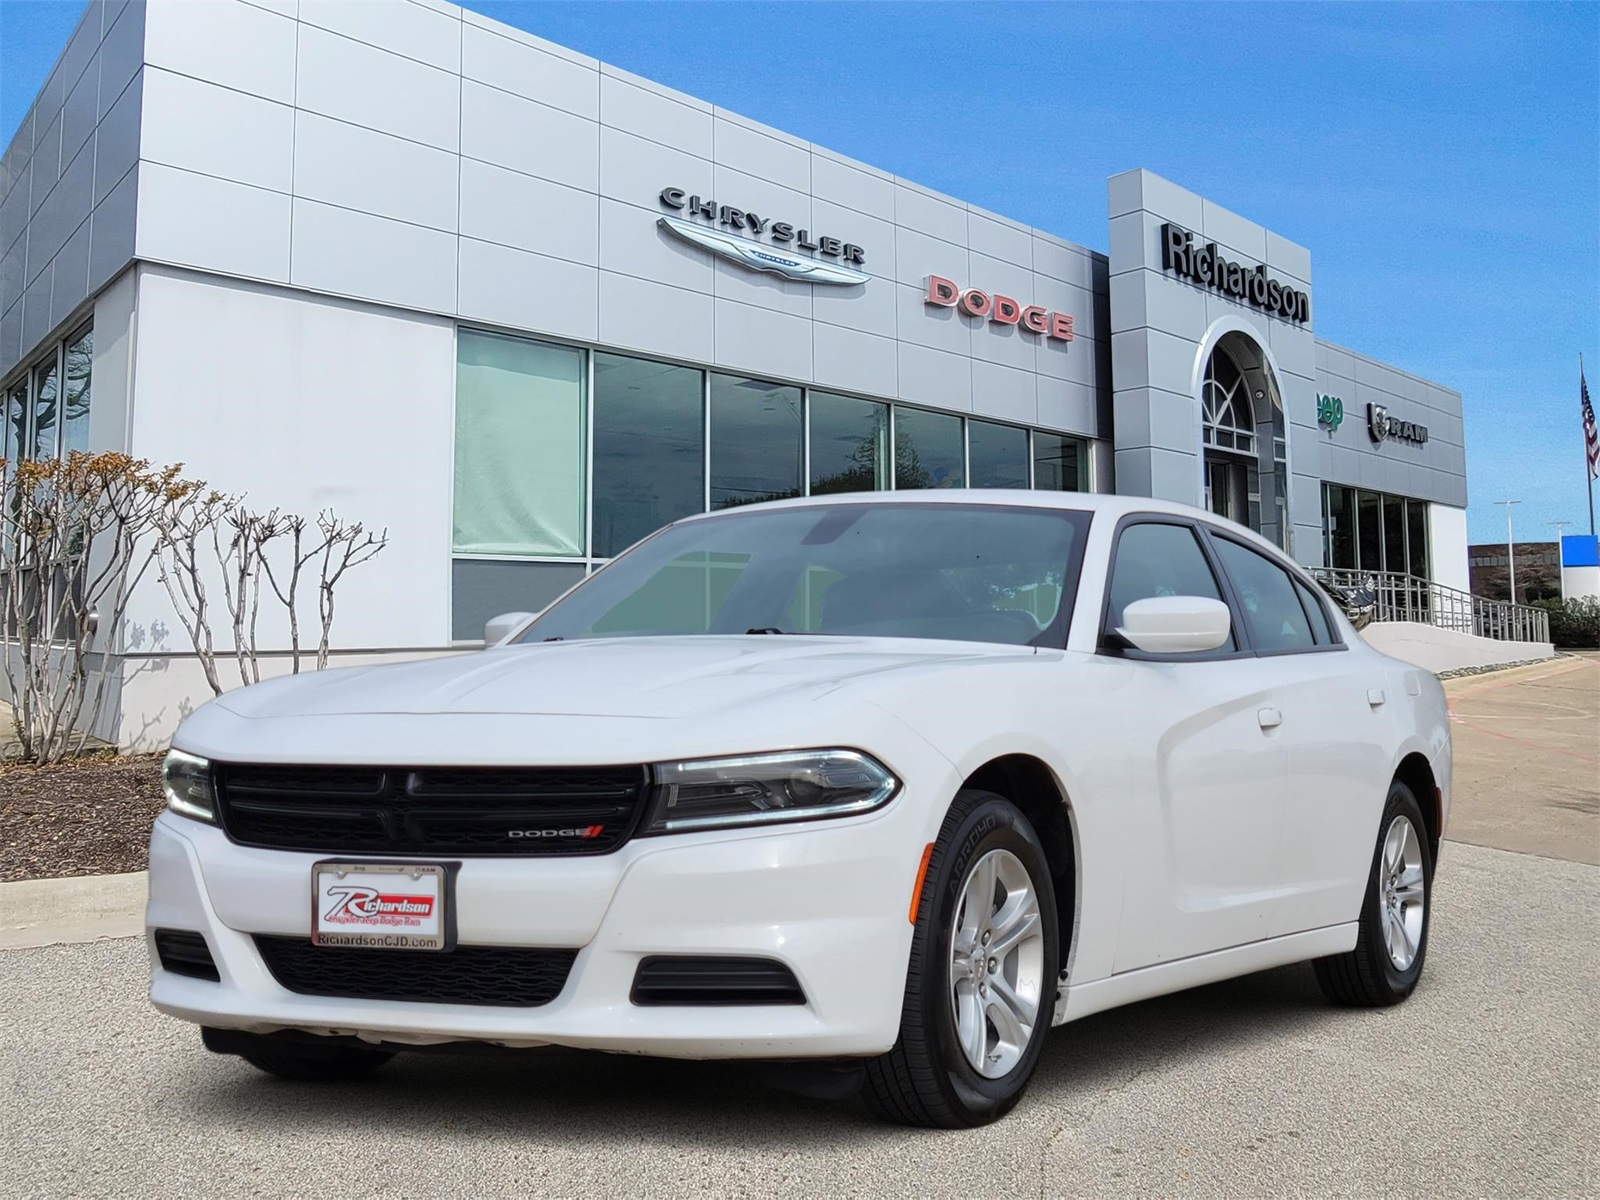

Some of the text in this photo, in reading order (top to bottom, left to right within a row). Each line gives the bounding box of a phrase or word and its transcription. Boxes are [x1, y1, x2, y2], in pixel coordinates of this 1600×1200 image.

[659, 187, 866, 264] CHRYSLER
[1161, 223, 1310, 323] Richardson
[923, 274, 1074, 342] DODGE
[1387, 416, 1429, 443] RAM
[508, 828, 590, 838] DODGE
[949, 815, 996, 898] ARROYO
[324, 886, 430, 921] Richardson
